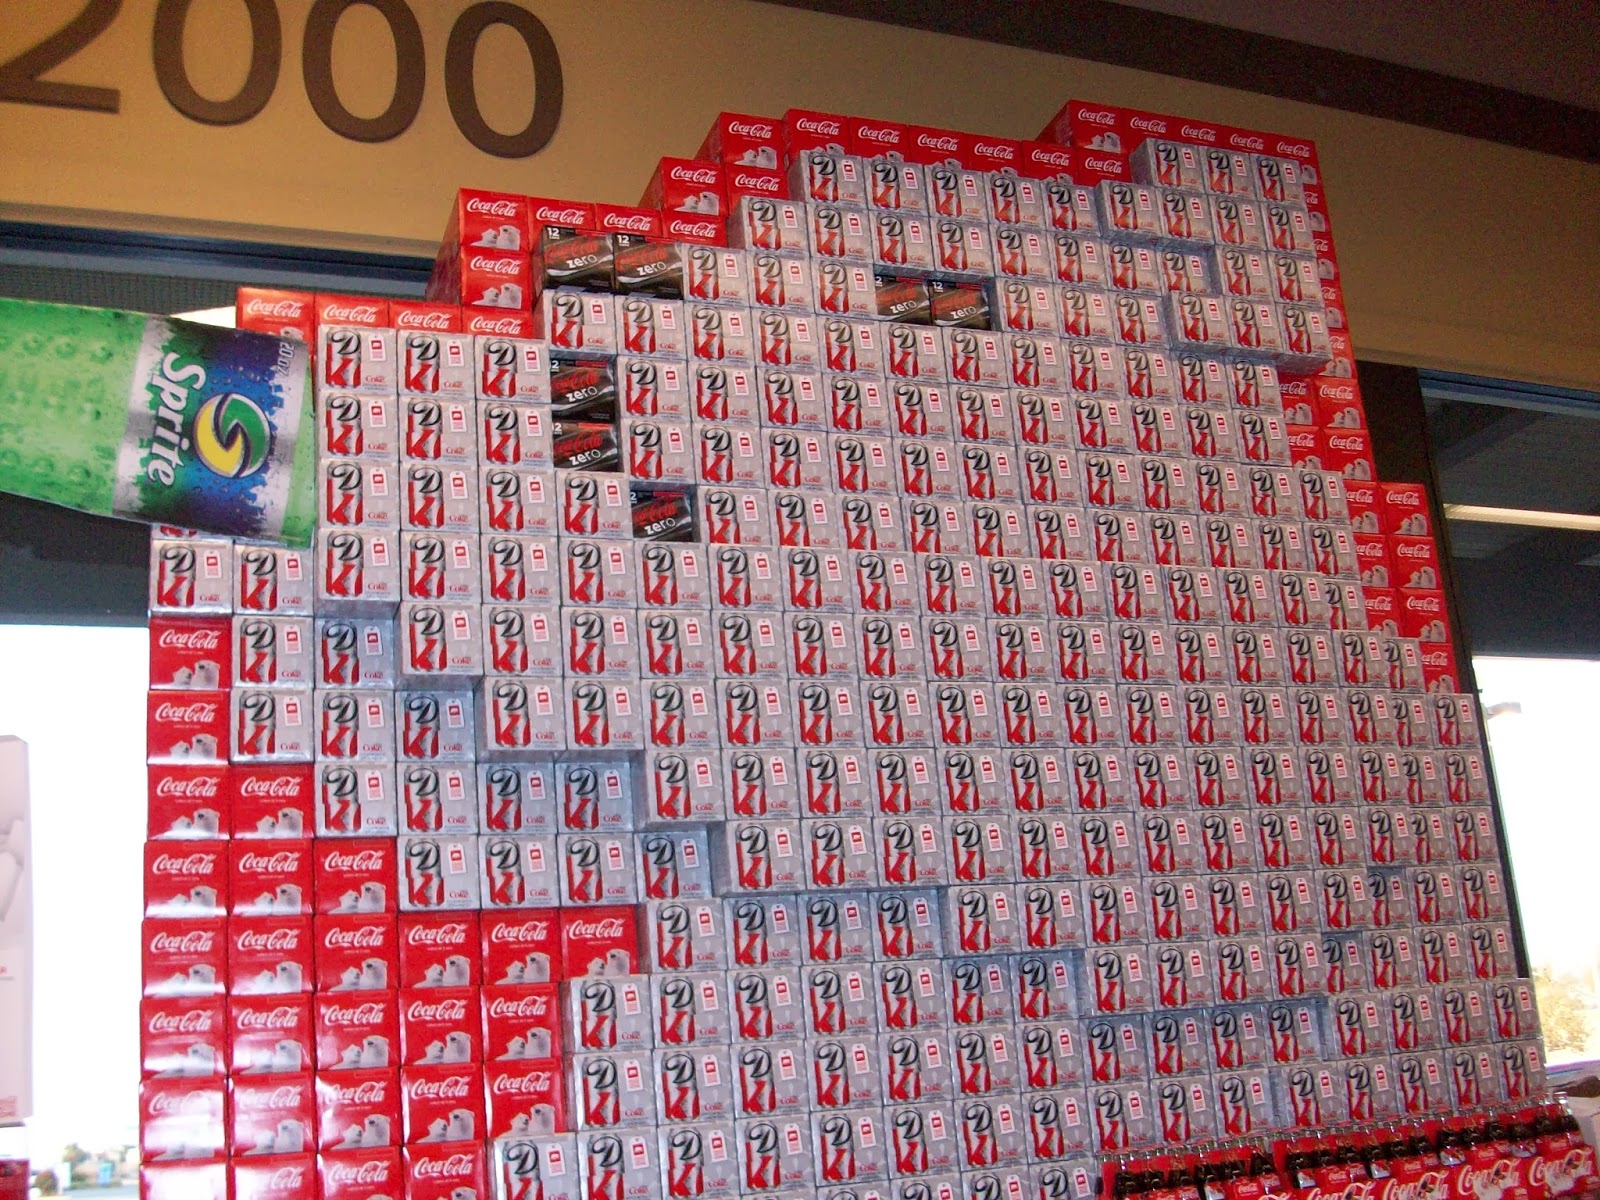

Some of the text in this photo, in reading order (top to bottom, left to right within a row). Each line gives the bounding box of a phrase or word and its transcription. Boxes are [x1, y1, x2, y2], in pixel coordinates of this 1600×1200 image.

[0, 0, 564, 159] 2000
[1078, 108, 1116, 126] Coca-Cola
[1130, 115, 1168, 134] Coca-Cola
[728, 121, 772, 139] Coca-Cola
[796, 118, 840, 136] Coca-Cola
[858, 125, 901, 144] Coca-Cola
[1181, 123, 1217, 142] Coca-Cola
[917, 133, 960, 151] Coca-Cola
[1230, 132, 1265, 151] Coca-Cola
[1276, 139, 1312, 158] Coca-Cola
[974, 142, 1015, 161] Coca-Cola
[1031, 148, 1070, 167] Coca-Cola
[670, 166, 717, 184] Coca-Cola
[1084, 156, 1122, 175] Coca-Cola
[734, 173, 779, 191] Coca-Cola
[466, 197, 517, 217] Coca-Cola
[536, 206, 586, 225] Coca-Cola
[603, 212, 653, 231] Coca-Cola
[670, 219, 717, 238] Coca-Cola
[547, 227, 560, 237] 12
[617, 235, 630, 244] 12
[470, 255, 521, 275] Coca-Cola
[566, 254, 598, 269] zero
[637, 261, 666, 276] zero
[932, 281, 943, 290] 12
[247, 299, 301, 317] Coca-Cola
[323, 304, 376, 323] Coca-Cola
[889, 300, 917, 314] zero
[950, 305, 977, 319] zero
[397, 310, 450, 329] Coca-Cola
[470, 316, 522, 335] Coca-Cola
[565, 386, 597, 402] zero
[1279, 381, 1307, 396] ca-Cola
[1319, 384, 1353, 400] Coca-Cola
[147, 351, 207, 486] Sprite
[1288, 432, 1315, 448] ca-Cola
[1329, 435, 1364, 450] Coca-Cola
[569, 449, 601, 466] zero
[1345, 489, 1373, 504] ca-Cola
[1386, 489, 1420, 506] Coca-Cola
[644, 518, 676, 535] zero
[1356, 542, 1383, 557] ca-Cola
[1397, 542, 1430, 559] Coca-Cola
[1365, 596, 1392, 611] ca-Cola
[1406, 595, 1440, 612] Coca-Cola
[160, 628, 221, 649] Coca-Cola
[1421, 651, 1448, 666] ca-Cola
[155, 702, 218, 722] Coca-Cola
[157, 776, 220, 797] Coca-Cola
[241, 776, 302, 796] Coca-Cola
[153, 853, 217, 875] Coca-Cola
[239, 851, 302, 872] Coca-Cola
[324, 850, 386, 871] Coca-Cola
[325, 926, 386, 948] Coca-Cola
[408, 923, 469, 945] Coca-Cola
[491, 920, 550, 943] Coca-Cola
[568, 918, 626, 939] Coca-Cola
[151, 931, 216, 953] Coca-Cola
[237, 928, 301, 950] Coca-Cola
[324, 1003, 386, 1025] Coca-Cola
[407, 999, 468, 1021] Coca-Cola
[490, 995, 549, 1017] Coca-Cola
[149, 1009, 215, 1033] Coca-Cola
[237, 1006, 300, 1029] Coca-Cola
[411, 1075, 472, 1099] Coca-Cola
[493, 1071, 552, 1094] Coca-Cola
[413, 1153, 475, 1176] Coca-Cola
